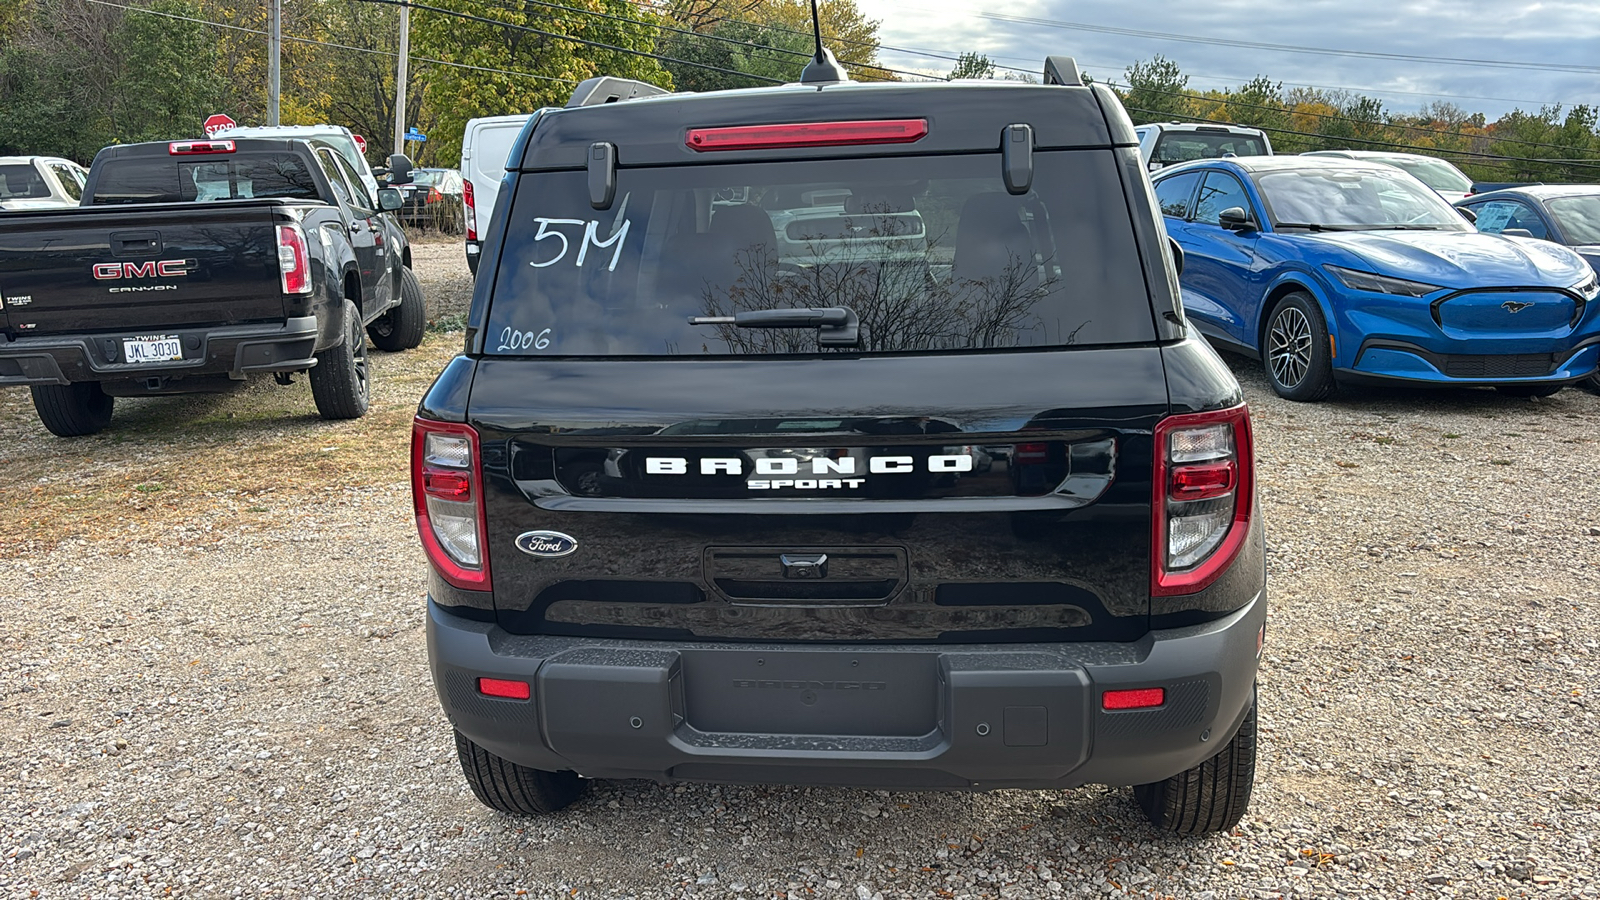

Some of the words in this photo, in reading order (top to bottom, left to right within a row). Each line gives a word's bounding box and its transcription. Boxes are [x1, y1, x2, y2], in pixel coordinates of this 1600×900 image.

[206, 122, 234, 134] STOP
[530, 217, 631, 272] 5M
[92, 259, 187, 280] GMC
[108, 284, 177, 293] CANYON
[497, 326, 551, 352] 2006
[128, 343, 149, 358] JKL
[150, 341, 179, 357] 3030
[646, 454, 973, 475] BRONCO
[747, 478, 866, 490] SPORT
[528, 535, 562, 552] Ford
